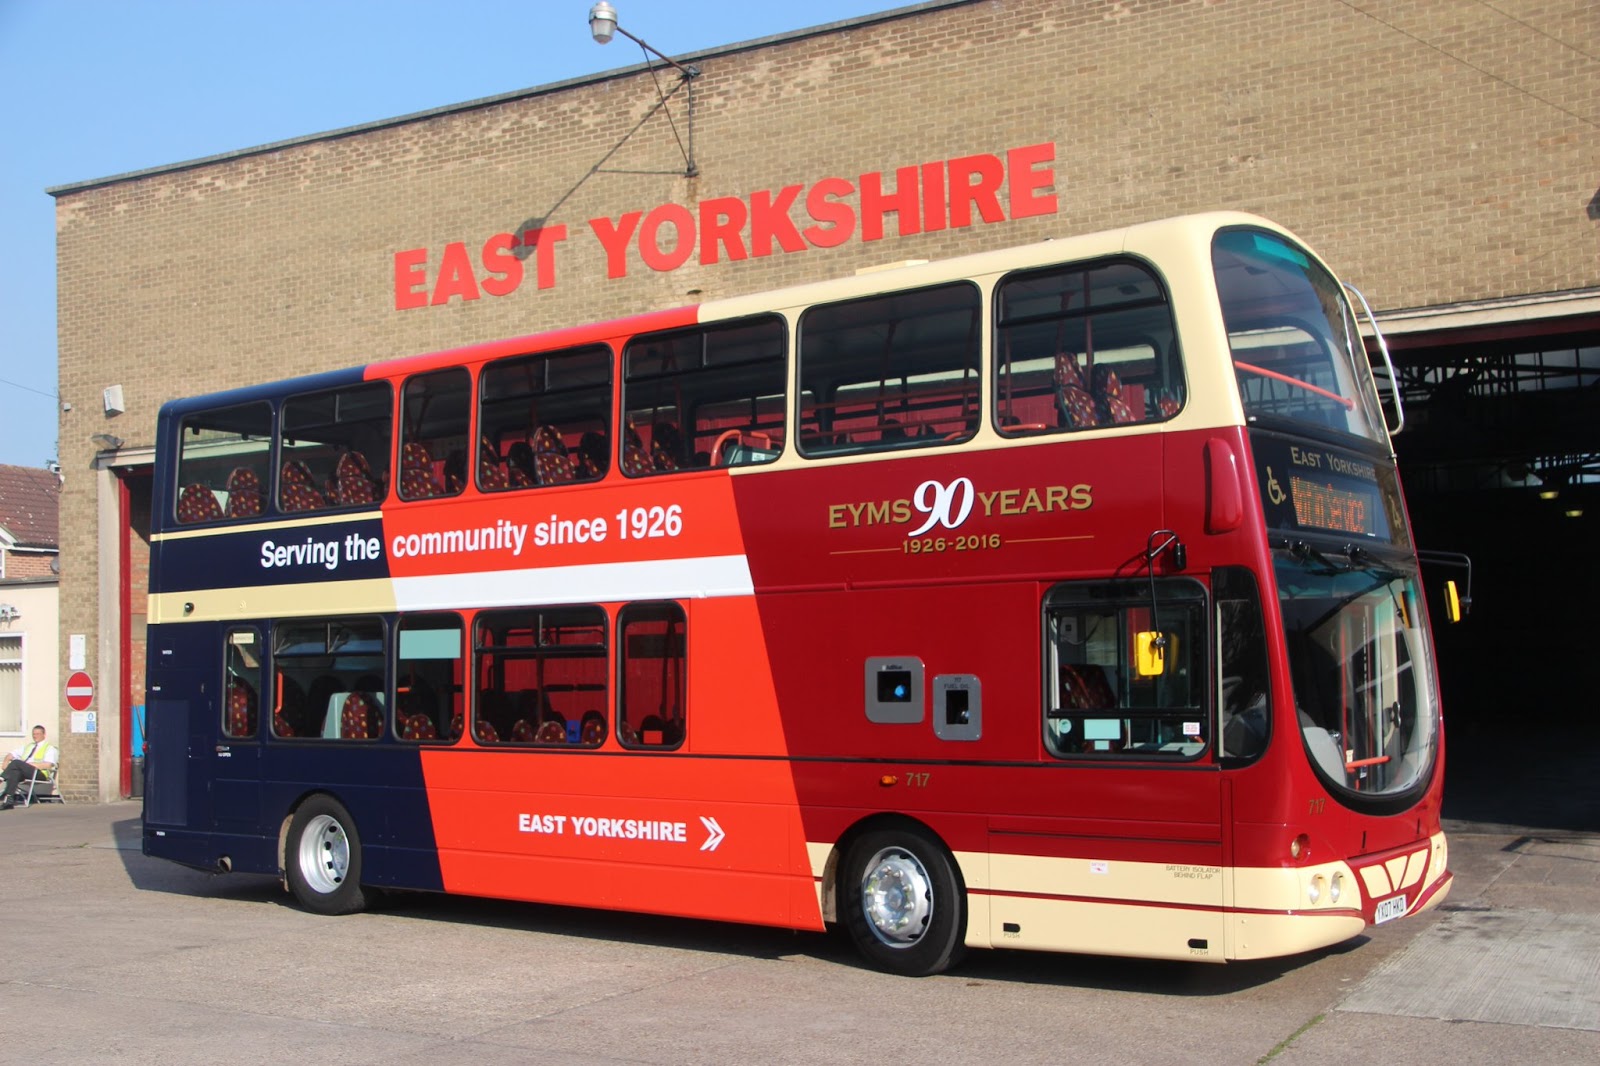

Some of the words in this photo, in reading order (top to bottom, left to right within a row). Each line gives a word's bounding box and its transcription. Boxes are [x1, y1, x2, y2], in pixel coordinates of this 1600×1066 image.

[394, 224, 567, 311] EAST
[589, 141, 1058, 279] YORKSHIRE
[1290, 446, 1321, 468] EAST
[1325, 453, 1377, 482] YORKSHIRE
[829, 499, 911, 528] EYMS
[908, 477, 974, 536] 90
[978, 483, 1093, 516] YEARS
[261, 533, 339, 570] Serving
[344, 533, 380, 561] the
[392, 520, 528, 557] community
[534, 516, 608, 547] since
[615, 504, 682, 540] 1926
[903, 534, 1001, 554] 1926-2016
[906, 772, 931, 788] 717
[1309, 798, 1326, 815] 717
[518, 813, 566, 834] EAST
[571, 816, 688, 843] YORKSHIRE
[1165, 864, 1190, 873] BATTERY
[1196, 872, 1213, 880] FLAP
[1190, 948, 1209, 956] PUSH
